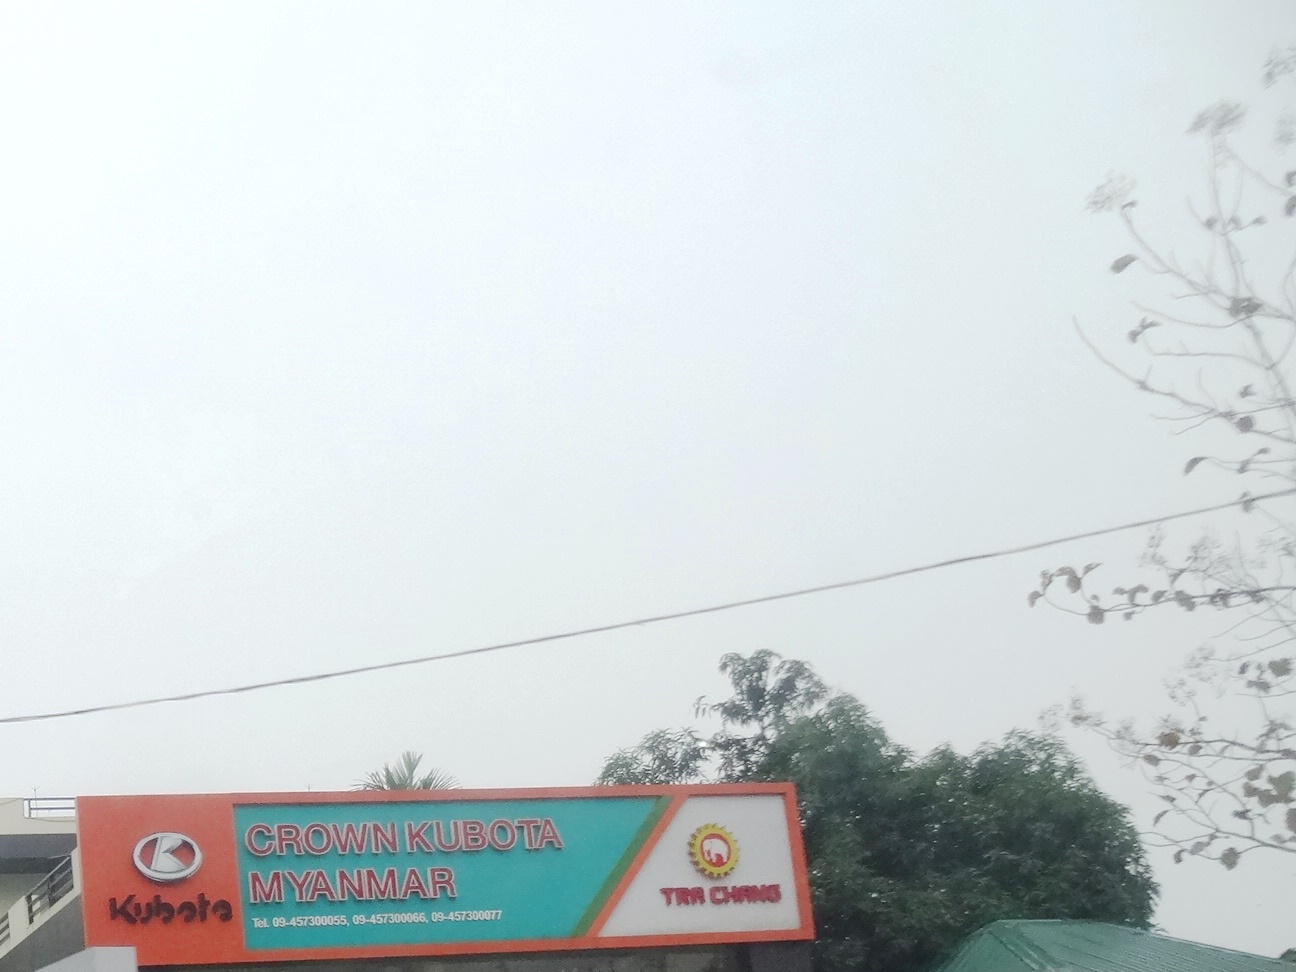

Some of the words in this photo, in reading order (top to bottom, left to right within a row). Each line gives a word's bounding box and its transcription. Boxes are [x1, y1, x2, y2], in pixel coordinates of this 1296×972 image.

[245, 820, 398, 857] CROWN
[406, 818, 564, 853] KUBOTA
[249, 867, 457, 904] MYANMAR
[109, 893, 234, 926] Kubota
[272, 914, 350, 928] 09-457300055,
[352, 912, 429, 926] 09-457300066,
[431, 909, 503, 923] 09-457300077
